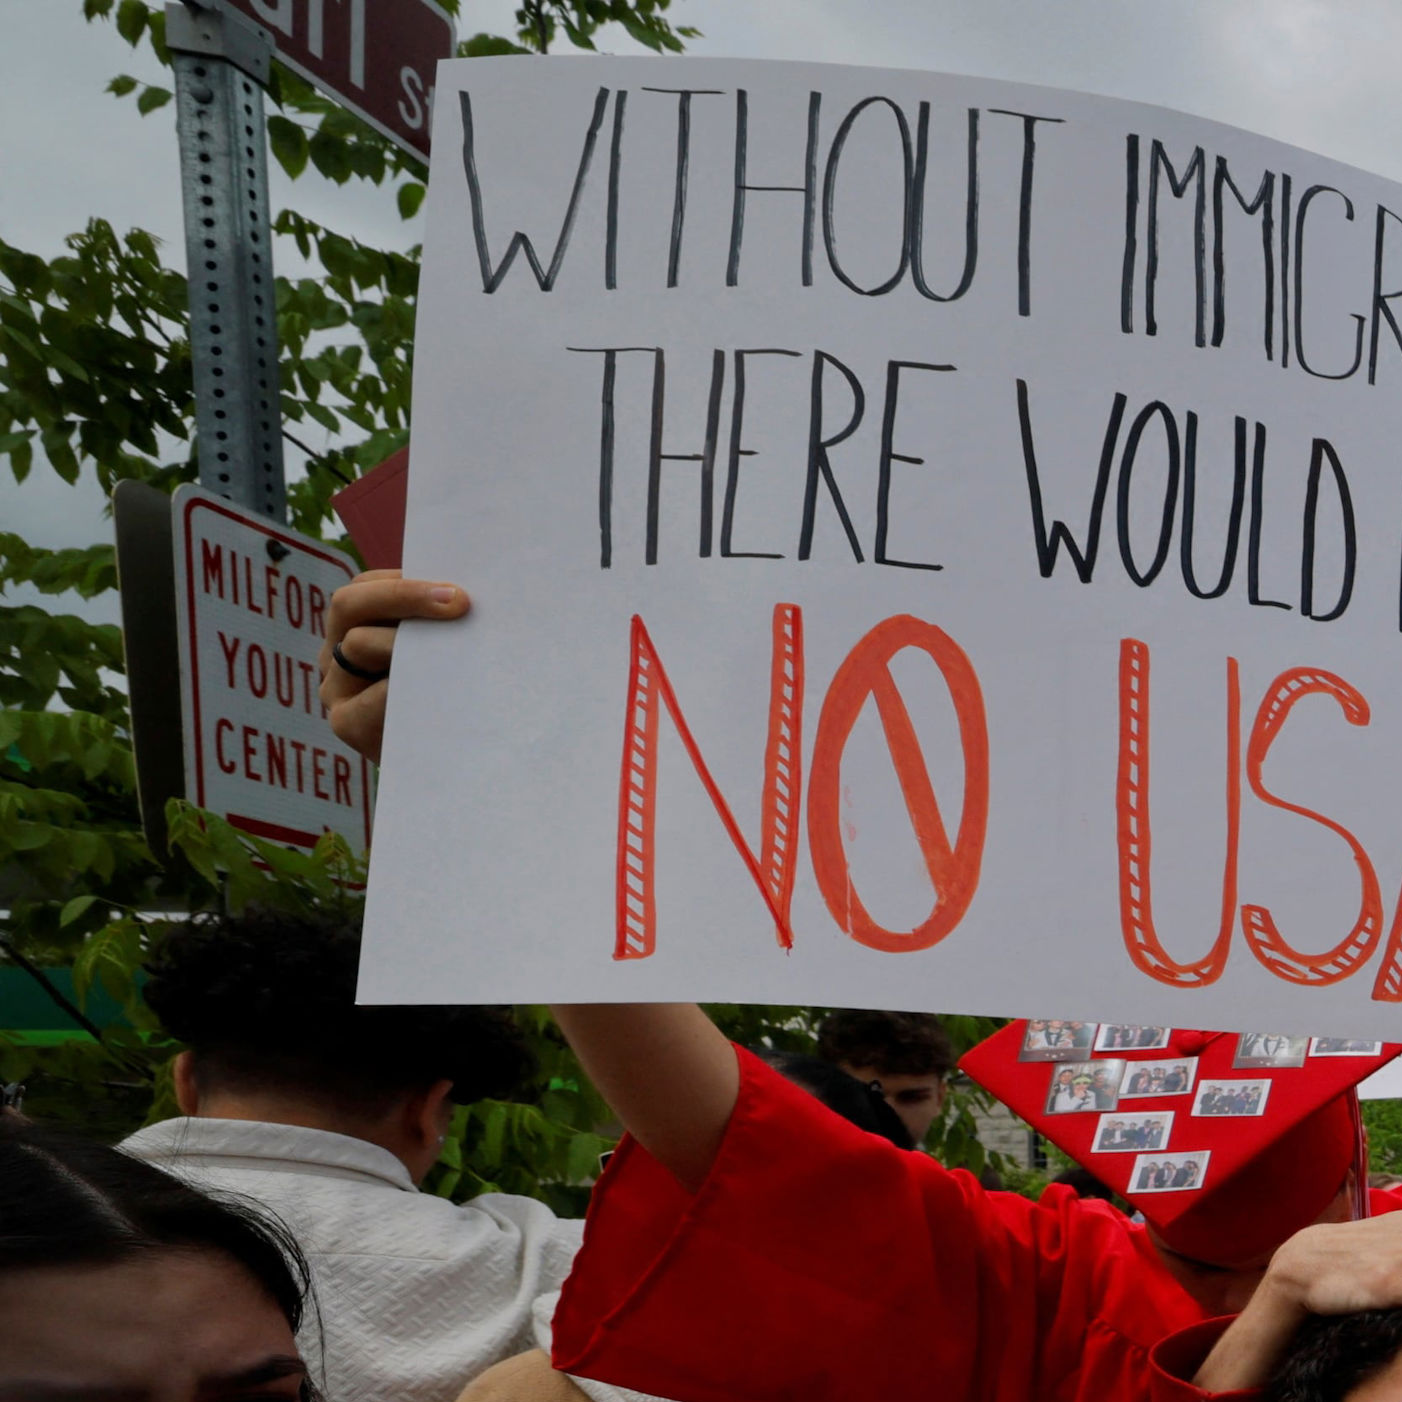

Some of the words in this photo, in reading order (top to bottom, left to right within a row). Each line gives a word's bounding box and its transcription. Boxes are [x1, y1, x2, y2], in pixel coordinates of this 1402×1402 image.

[460, 87, 1065, 317] WITHOUT
[566, 345, 957, 570] THERE
[1016, 378, 1358, 623] WOULD
[202, 538, 336, 640] MILFOR
[217, 631, 328, 720] YOUT
[215, 717, 353, 807] CENTER
[612, 602, 989, 960] NO
